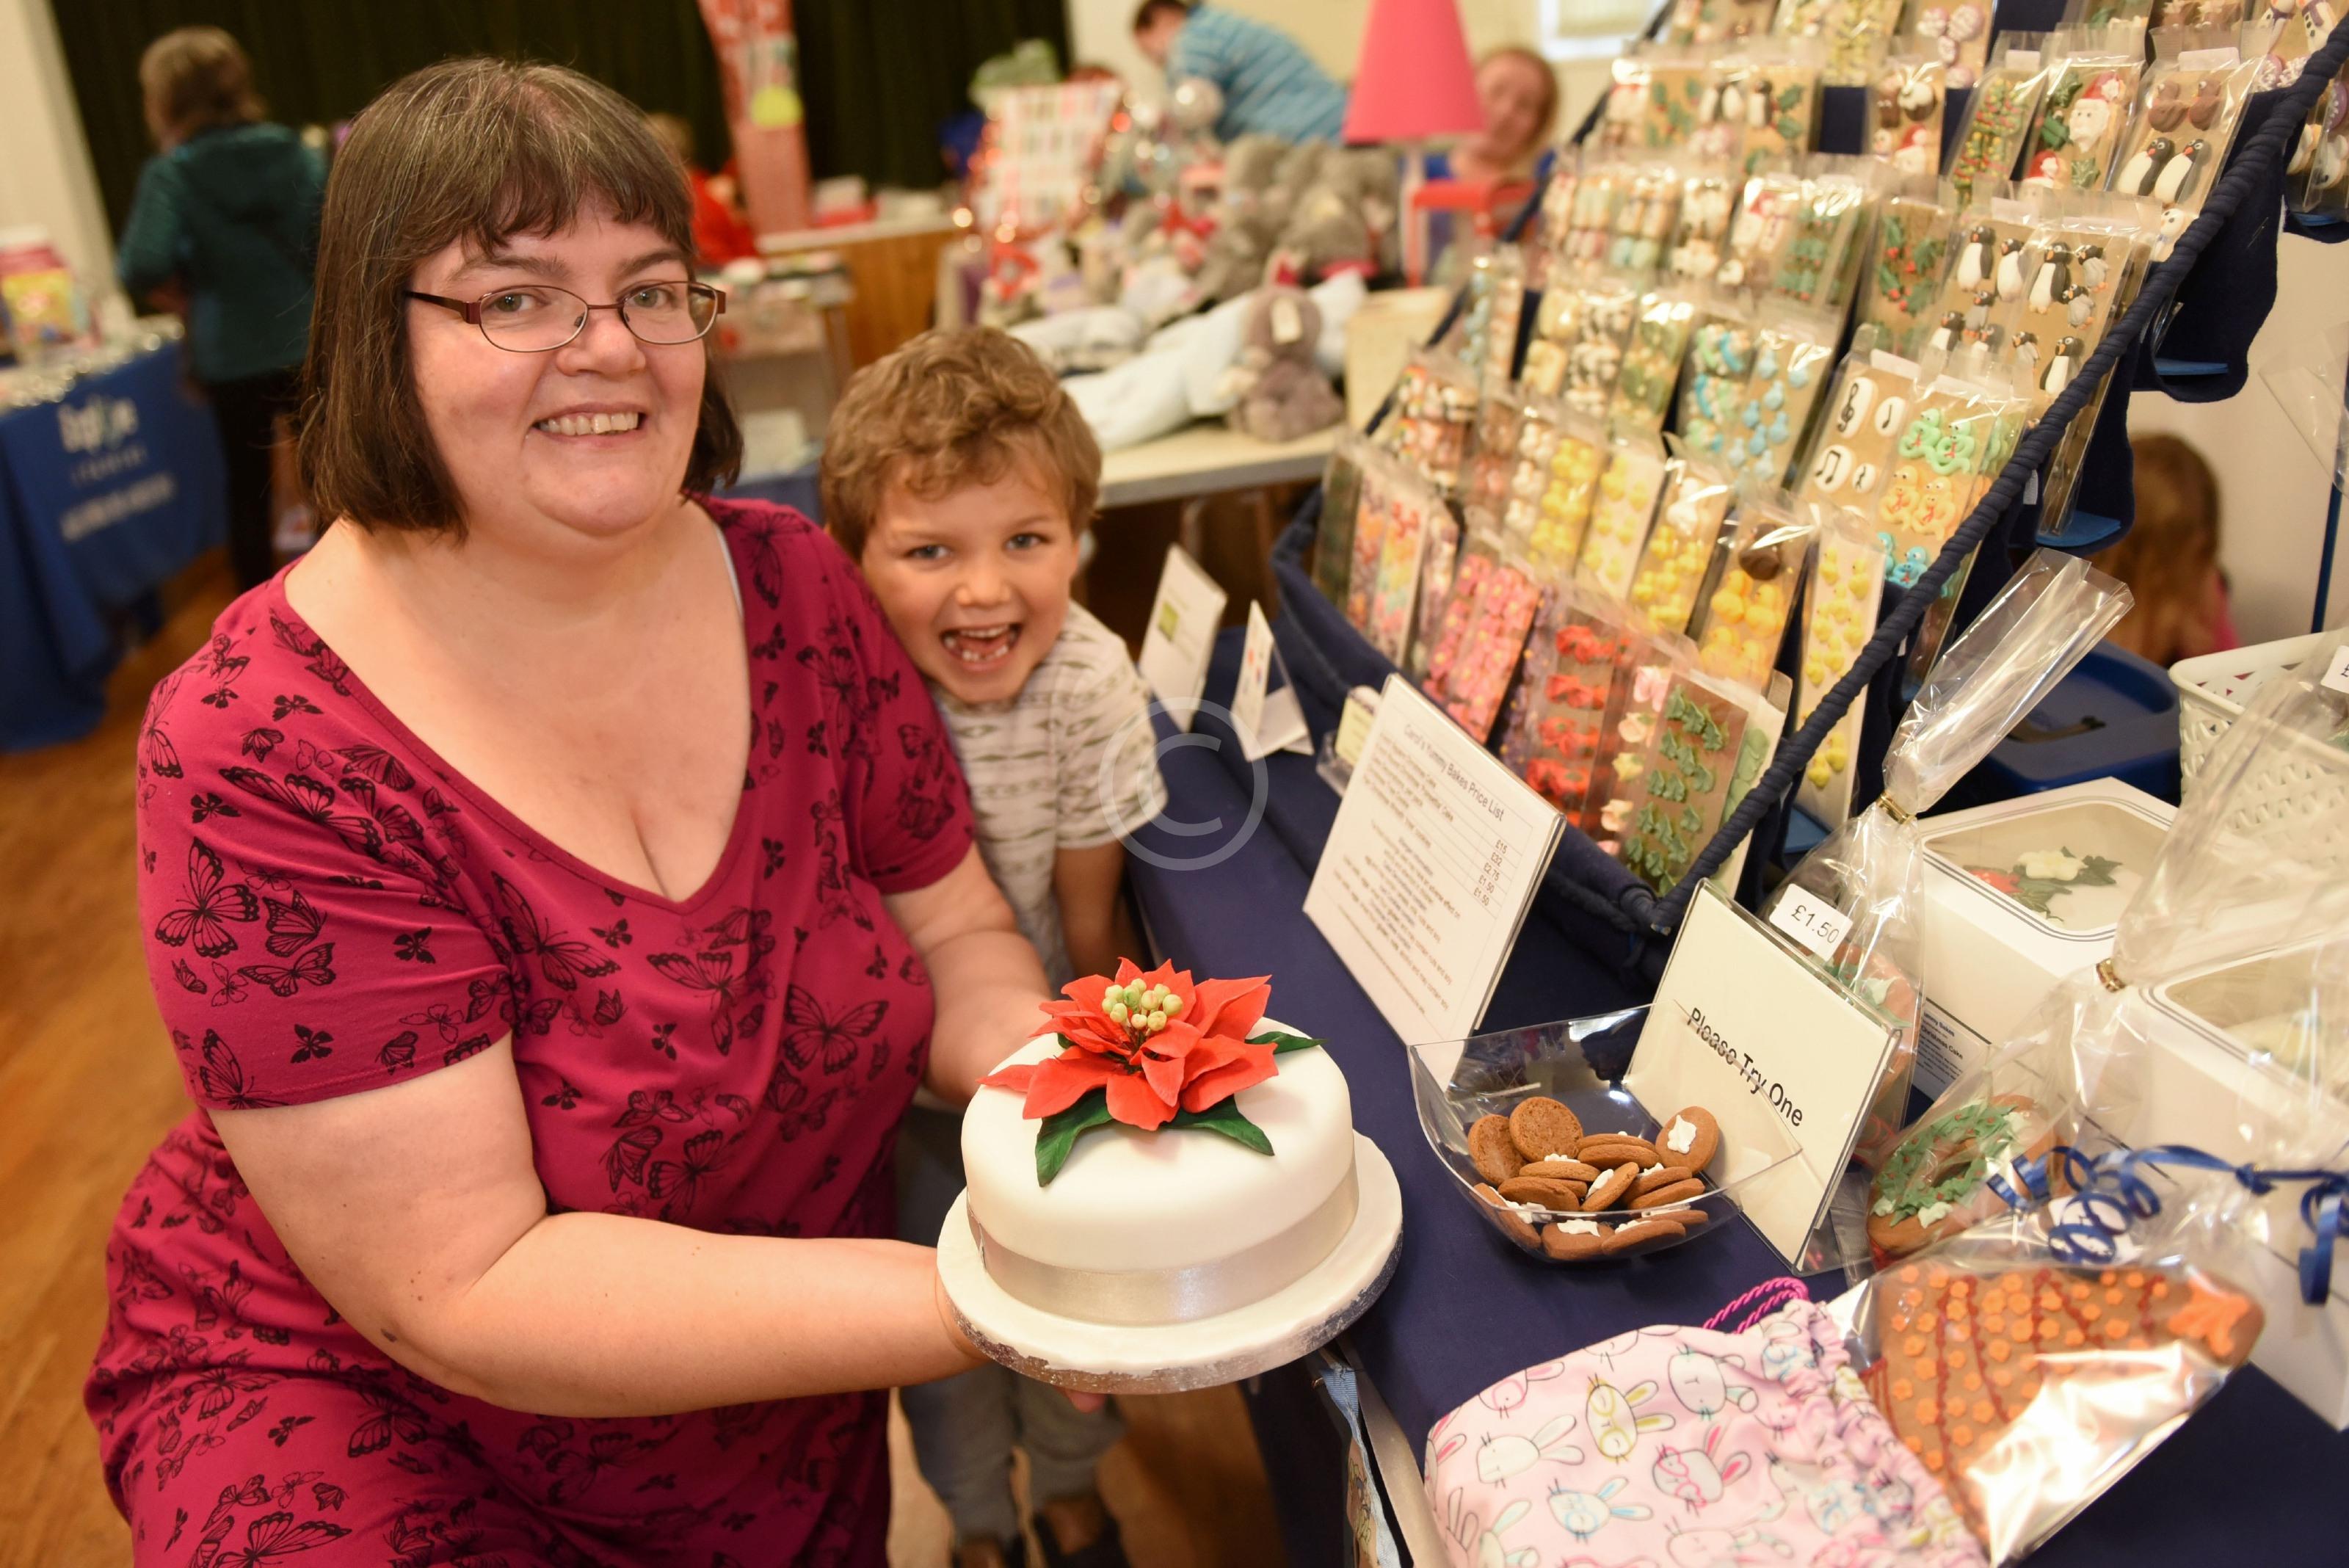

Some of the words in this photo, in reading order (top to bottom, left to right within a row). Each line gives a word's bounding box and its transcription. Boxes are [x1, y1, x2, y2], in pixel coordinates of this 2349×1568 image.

[1447, 762, 1470, 791] Bakes
[1468, 781, 1489, 808] Price
[1487, 799, 1506, 822] List
[1495, 838, 1508, 856] £15
[1490, 850, 1503, 868] £32
[1483, 861, 1500, 883] £2.75
[1478, 873, 1495, 896] £1.50
[1473, 885, 1490, 908] £1.50
[1791, 904, 1840, 944] £1.50
[1687, 1007, 1738, 1065] Please
[1740, 1053, 1768, 1095] Try
[1769, 1083, 1803, 1127] One
